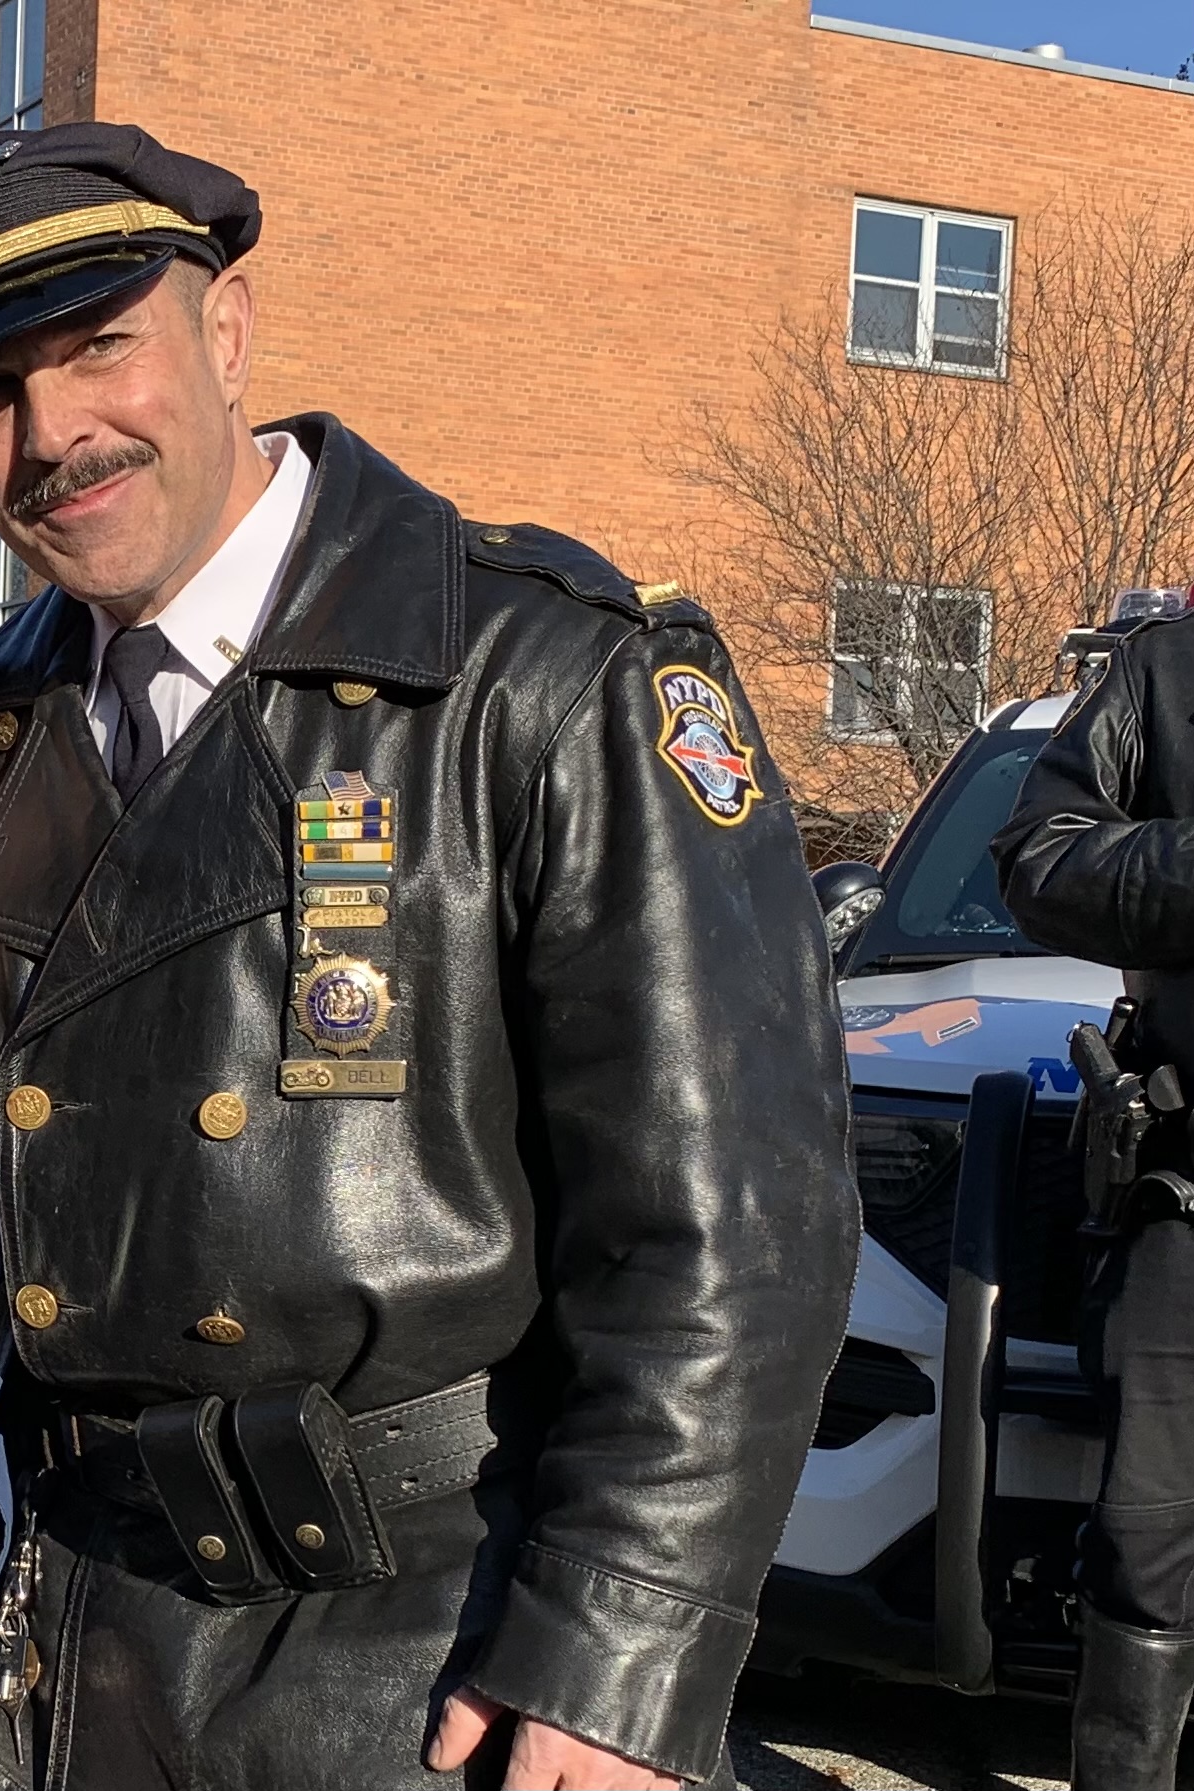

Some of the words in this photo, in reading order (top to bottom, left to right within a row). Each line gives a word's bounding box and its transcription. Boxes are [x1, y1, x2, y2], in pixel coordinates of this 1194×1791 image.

[664, 675, 727, 722] NYPD
[328, 890, 363, 903] NYPD
[347, 1069, 391, 1084] BELL
